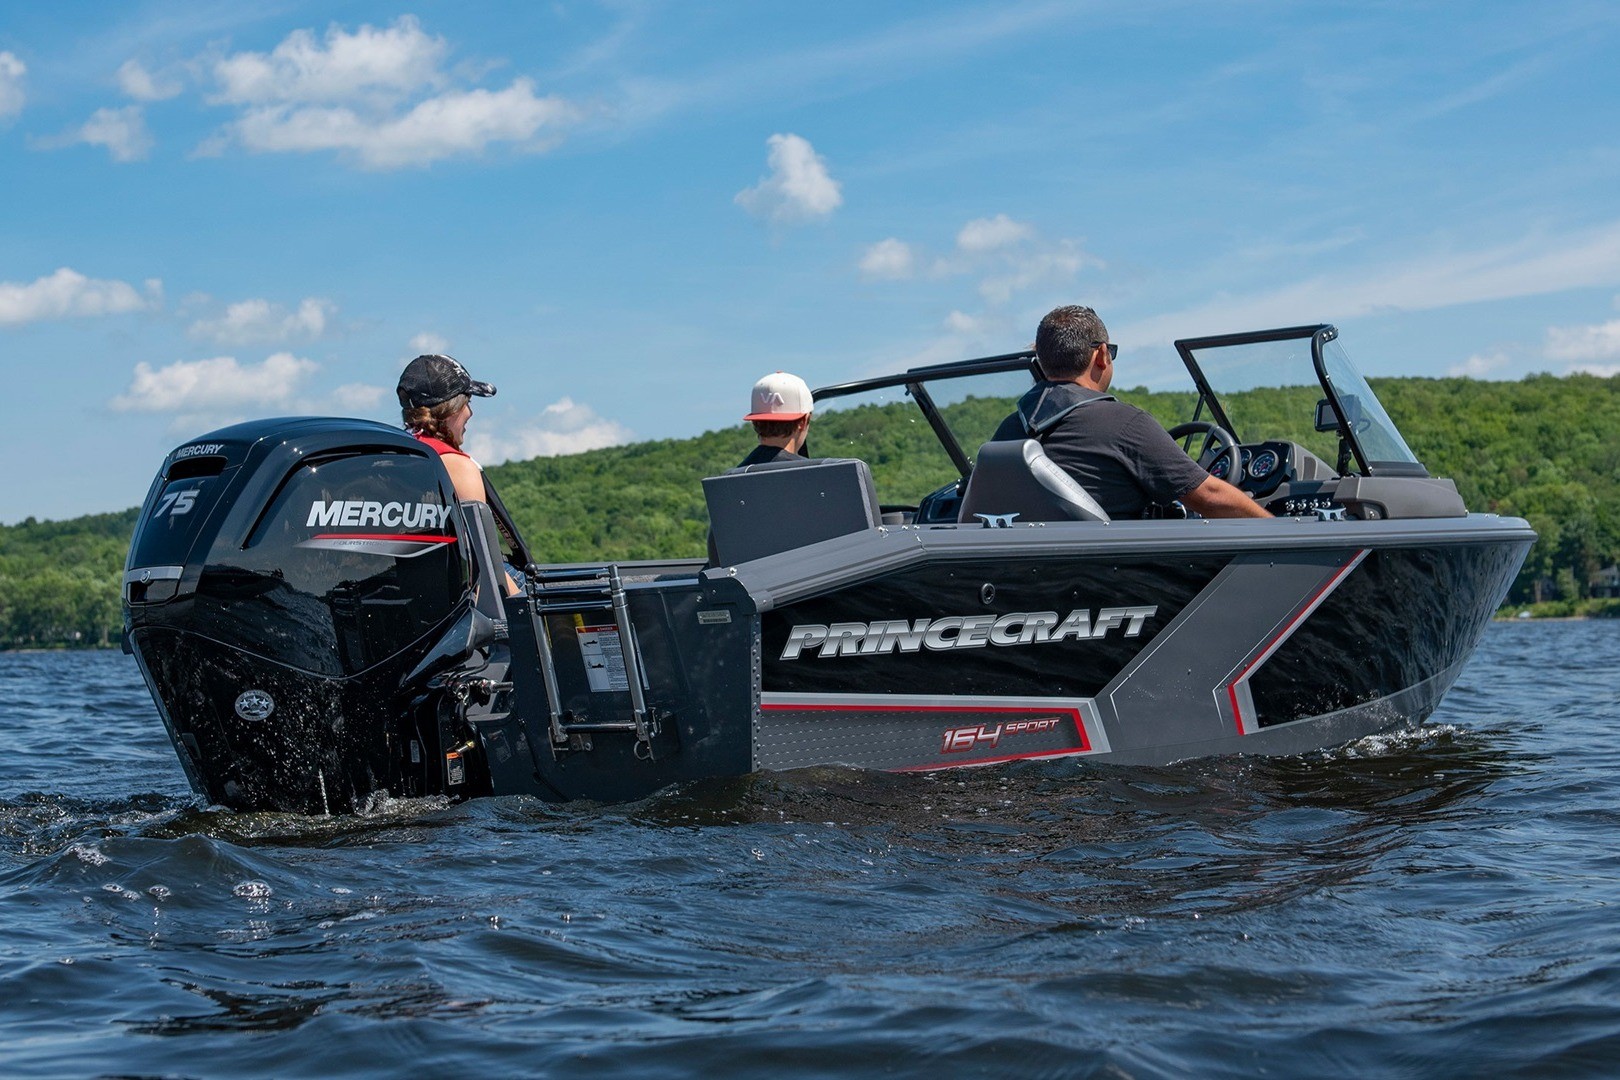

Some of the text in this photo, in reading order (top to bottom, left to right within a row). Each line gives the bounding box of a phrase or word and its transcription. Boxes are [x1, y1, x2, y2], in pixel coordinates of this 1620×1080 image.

[176, 444, 224, 458] MERCURY
[154, 490, 200, 518] 75
[306, 501, 452, 529] MERCURY
[779, 605, 1158, 660] PRINCECRAFT
[940, 717, 1060, 754] 164 SPORT
